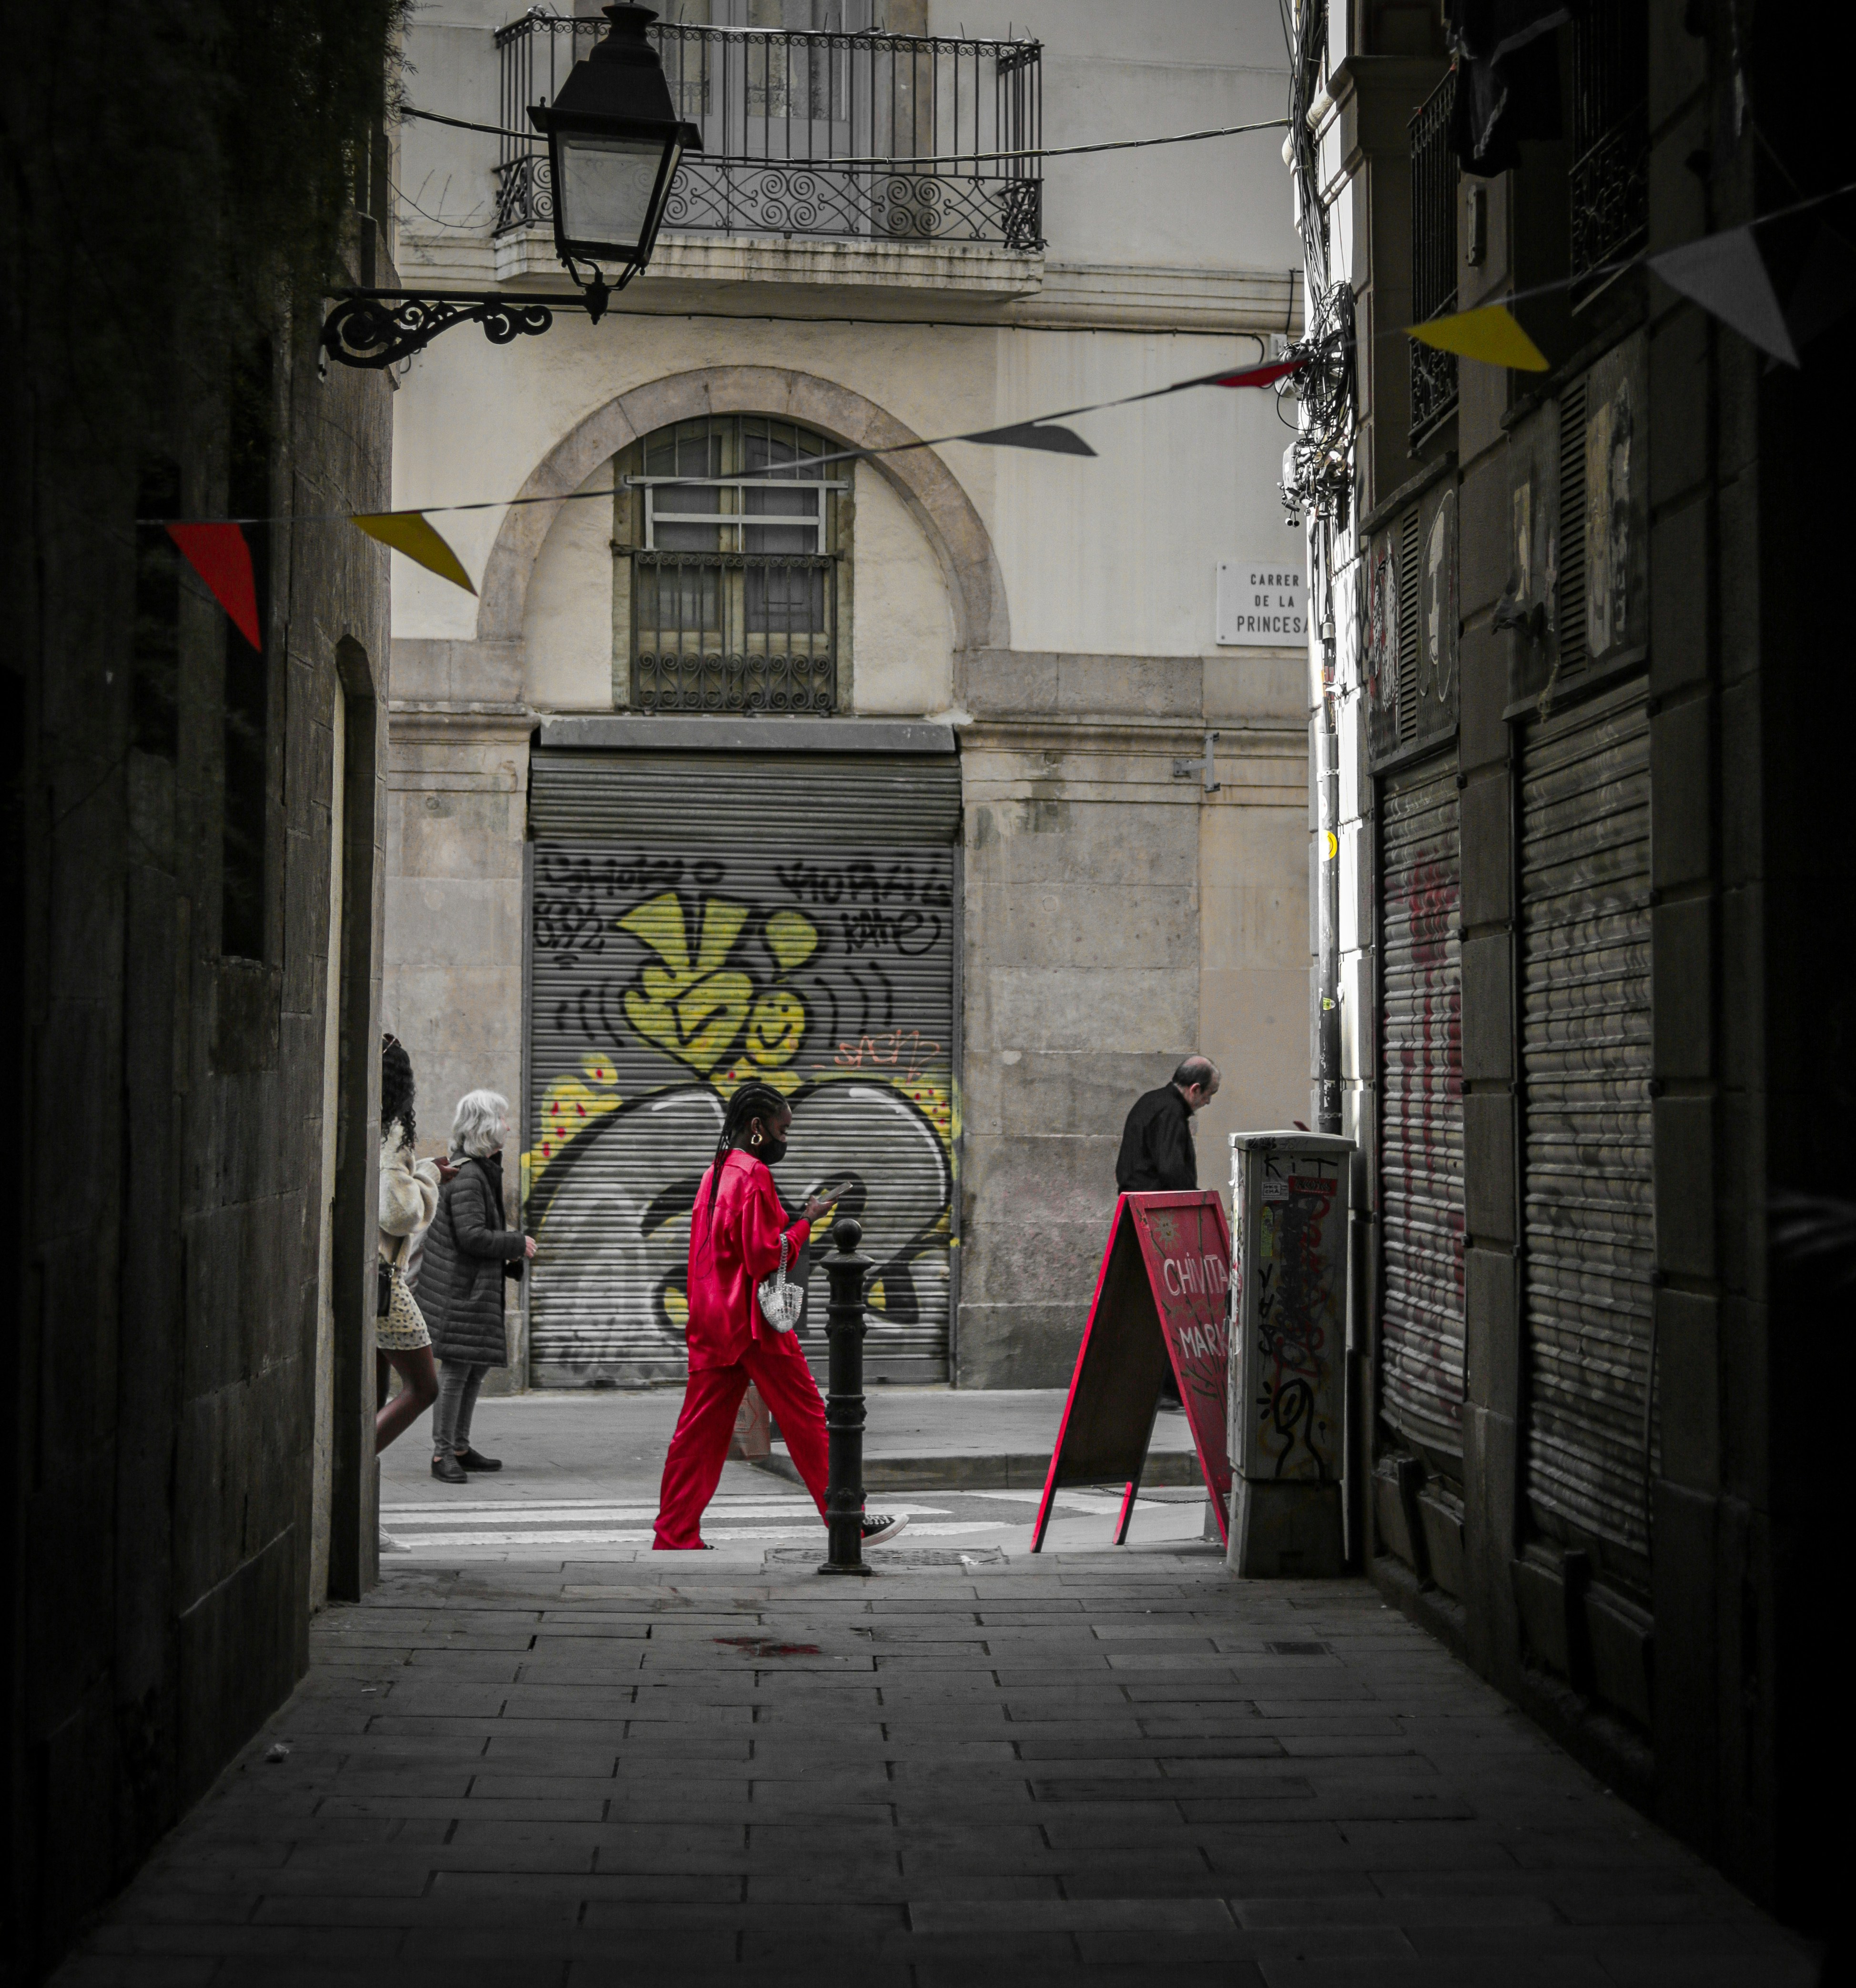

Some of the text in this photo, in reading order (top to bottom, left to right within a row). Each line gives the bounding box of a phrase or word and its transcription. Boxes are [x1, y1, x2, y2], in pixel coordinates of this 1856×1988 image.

[1250, 574, 1299, 586] CARRER
[1255, 595, 1295, 607] DE LA
